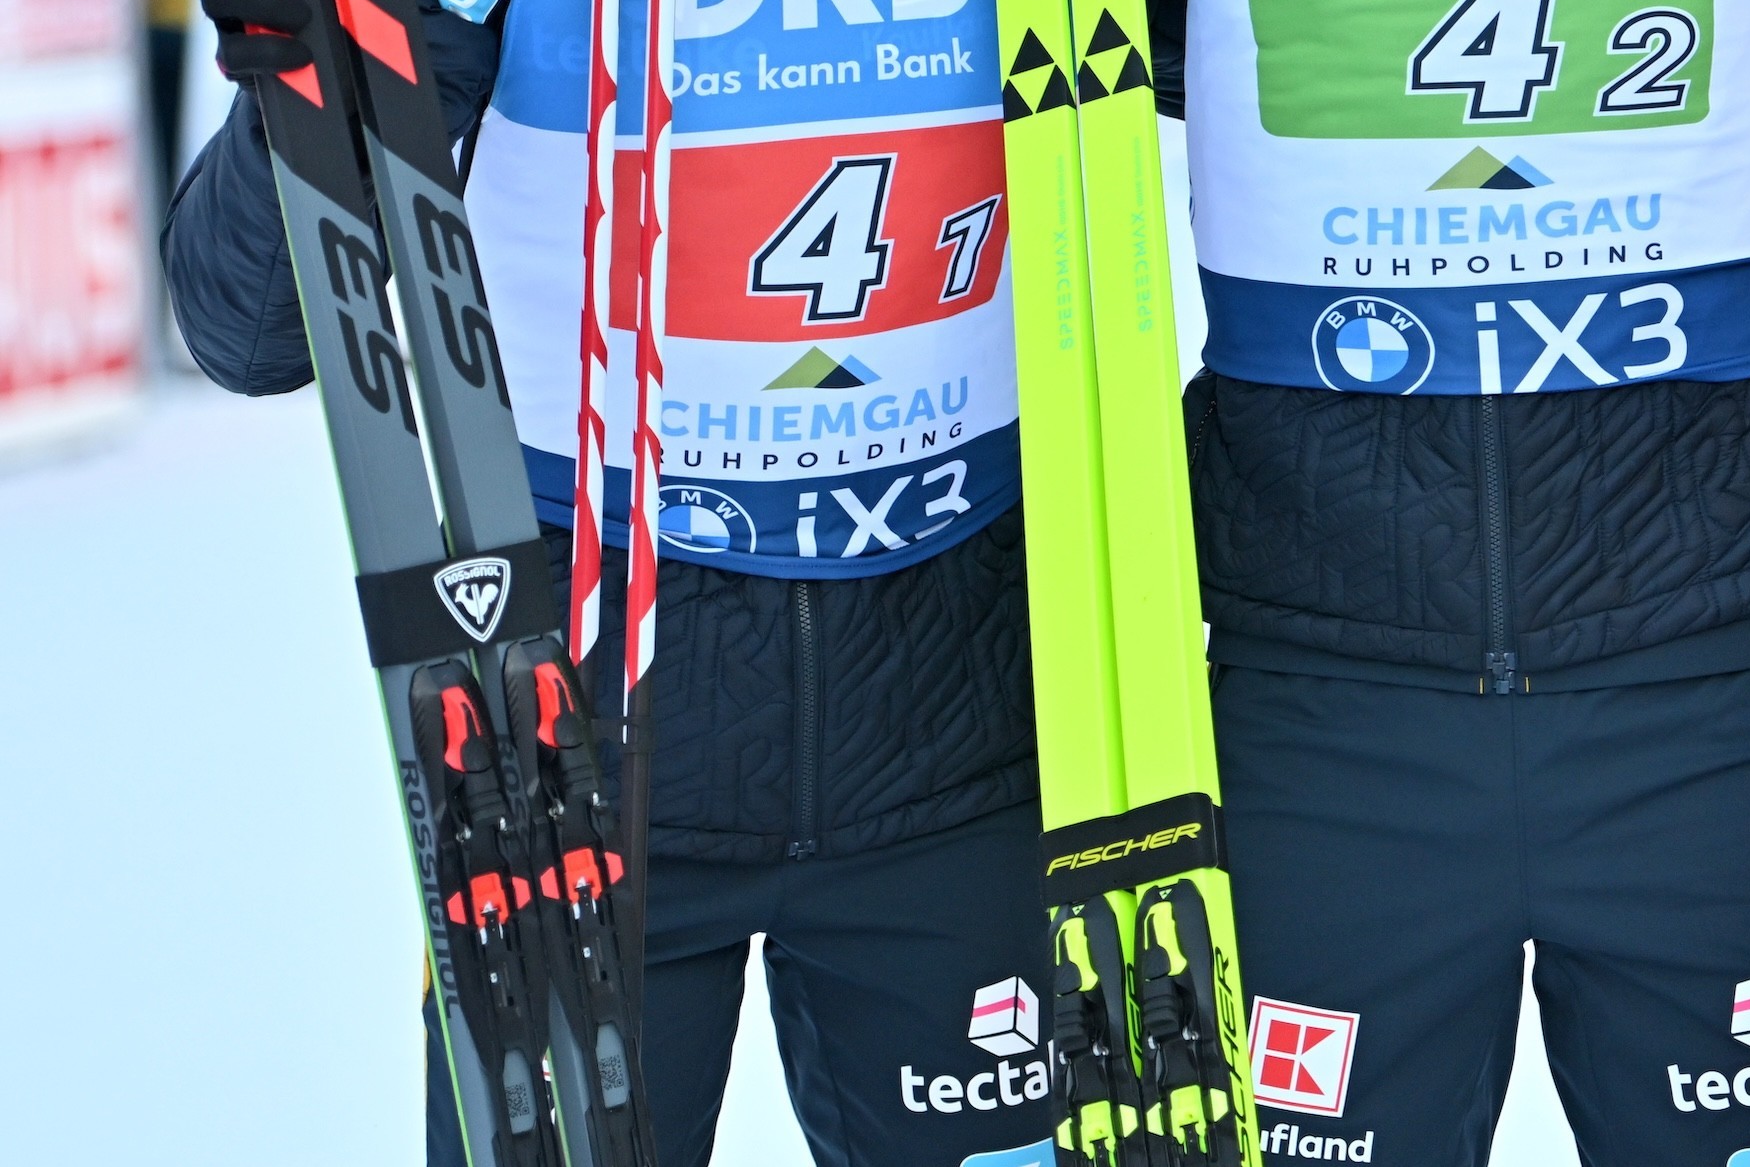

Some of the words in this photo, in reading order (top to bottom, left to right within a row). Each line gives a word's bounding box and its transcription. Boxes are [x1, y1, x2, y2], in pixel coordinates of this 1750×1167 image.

[672, 63, 742, 99] Das
[757, 53, 861, 92] kann
[875, 36, 976, 80] Bank
[1593, 5, 1701, 117] 2
[746, 152, 899, 326] 4
[934, 192, 1004, 305] 1
[1321, 193, 1662, 247] CHIEMGAU
[1323, 242, 1664, 277] RUHPOLDING
[1327, 300, 1416, 332] BMW
[1474, 282, 1689, 396] iX3
[660, 375, 969, 442] CHIEMGAU
[443, 566, 503, 587] ROSSIGNOL
[1046, 821, 1202, 877] FISCHER
[900, 1058, 1049, 1114] tecta
[1257, 1125, 1374, 1163] ufland
